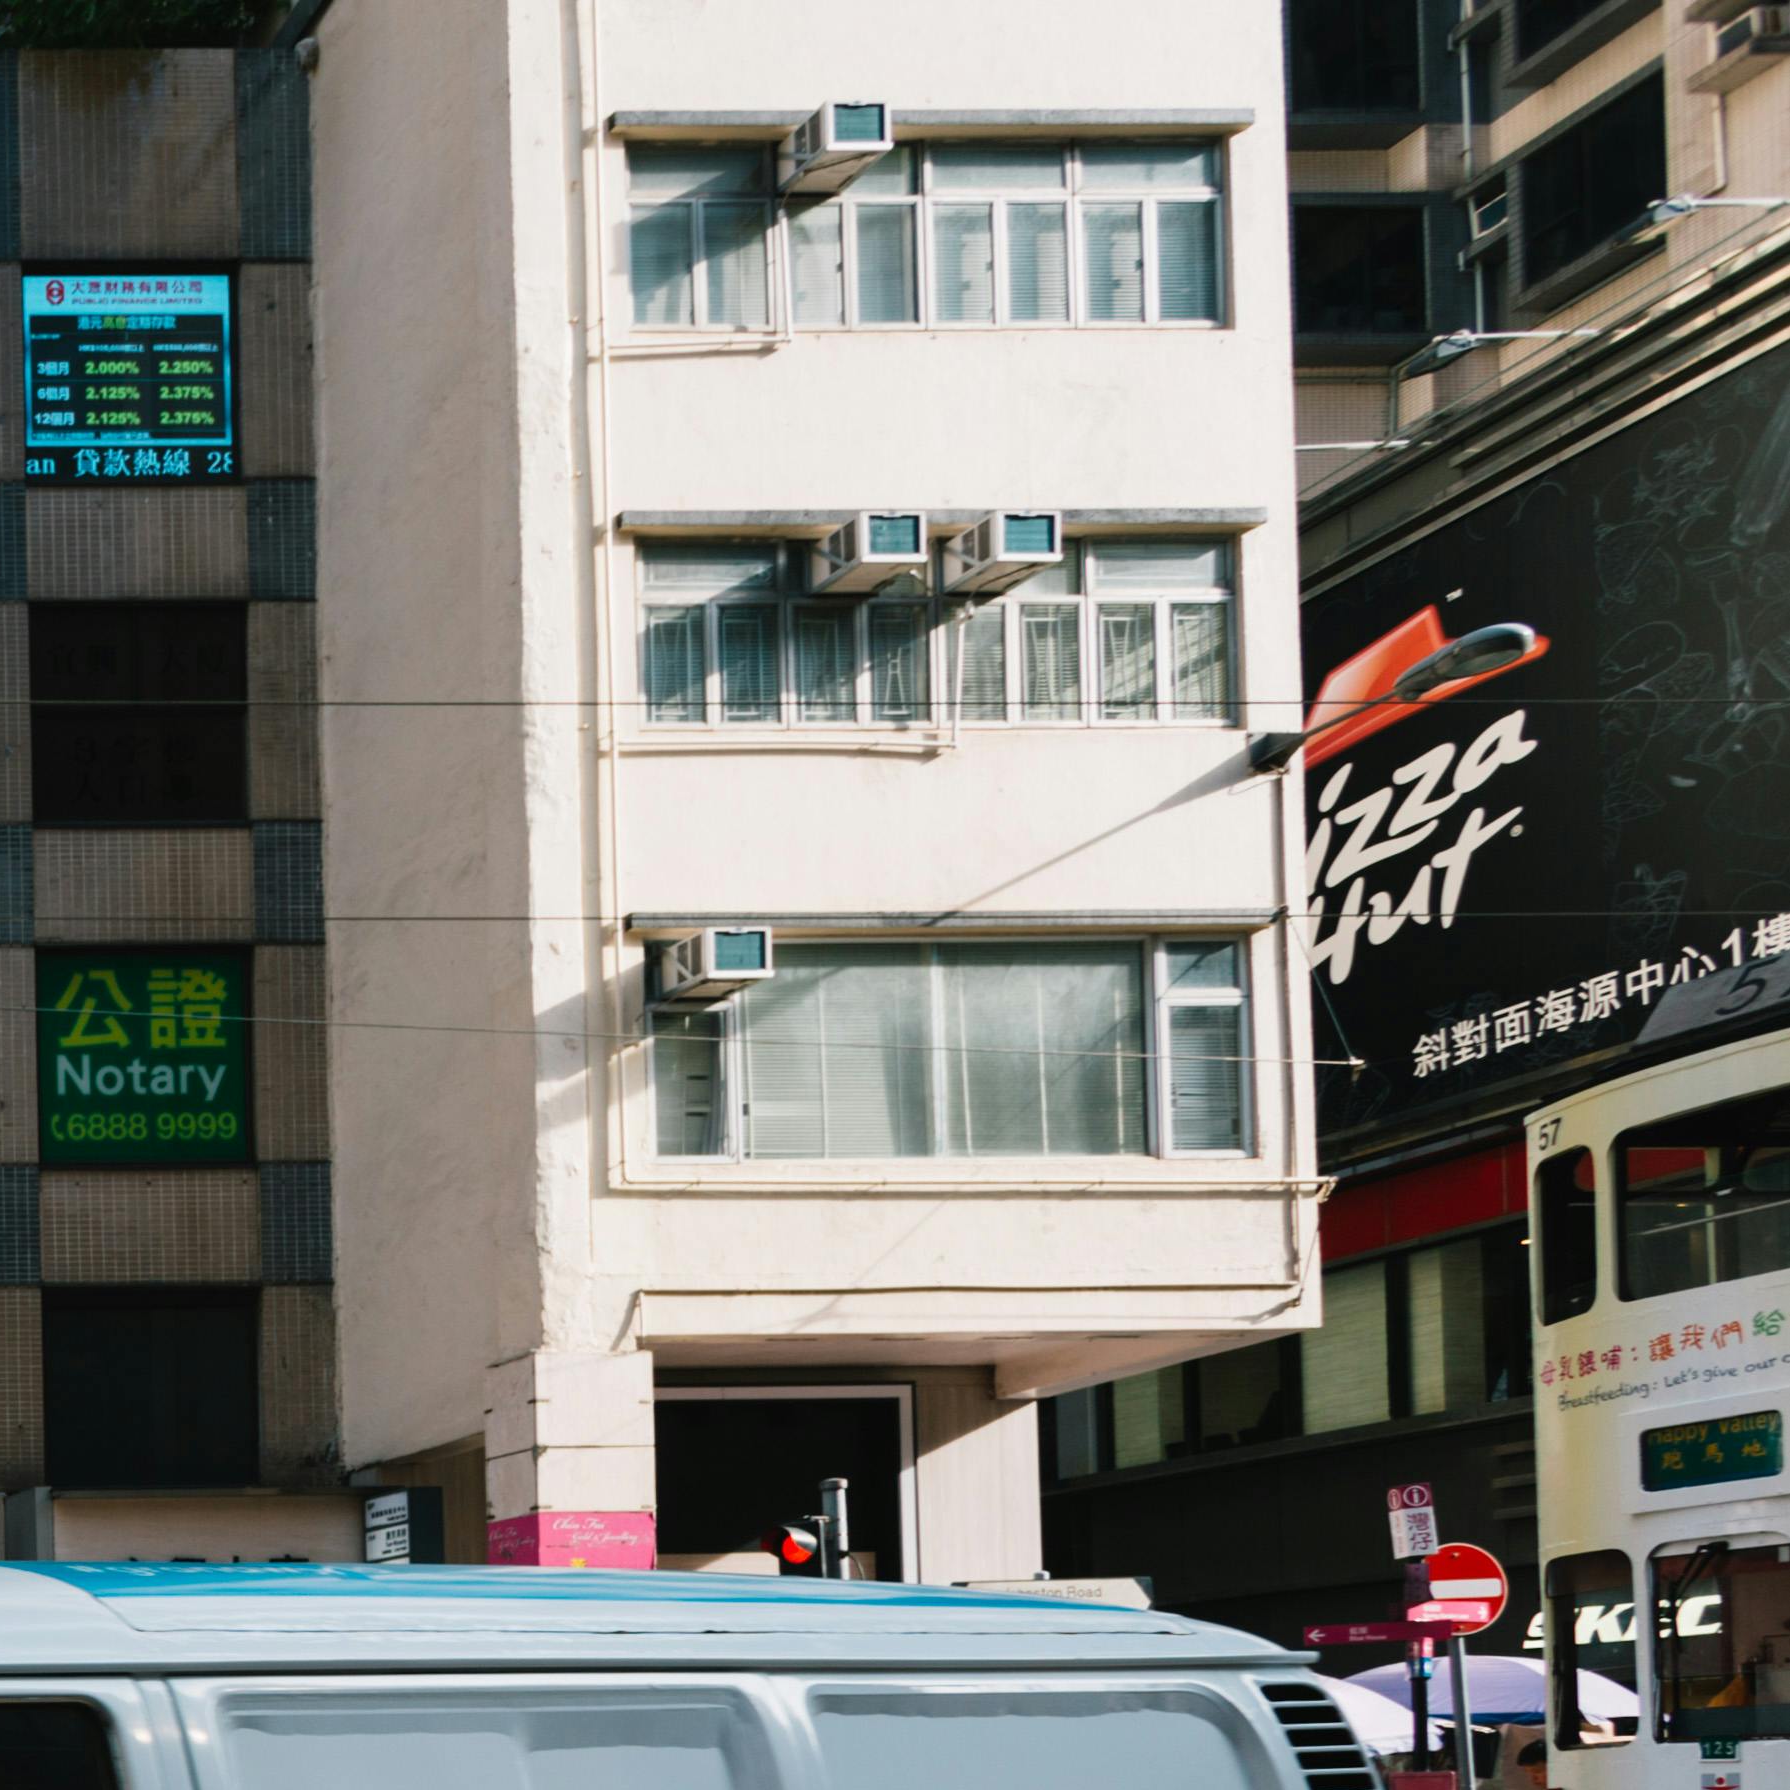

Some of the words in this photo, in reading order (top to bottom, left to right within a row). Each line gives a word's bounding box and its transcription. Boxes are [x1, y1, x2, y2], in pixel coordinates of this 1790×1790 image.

[85, 362, 140, 375] 2.000%
[159, 361, 213, 374] 2.250%
[86, 387, 140, 400] 2.125%
[160, 387, 214, 400] 2.375%
[86, 412, 141, 425] 2.125%
[160, 412, 214, 425] 2.375%
[26, 458, 56, 474] an
[73, 449, 191, 476] 貸款熱線
[1307, 709, 1538, 896] izza
[56, 969, 228, 1049] 公證
[56, 1055, 226, 1102] Notary
[67, 1113, 147, 1142] 6888
[155, 1112, 237, 1140] 9999
[1538, 1118, 1562, 1150] 57
[1703, 1366, 1739, 1383] give
[1744, 1357, 1776, 1372] our
[1067, 1586, 1102, 1598] Road
[1703, 1741, 1734, 1755] 125
